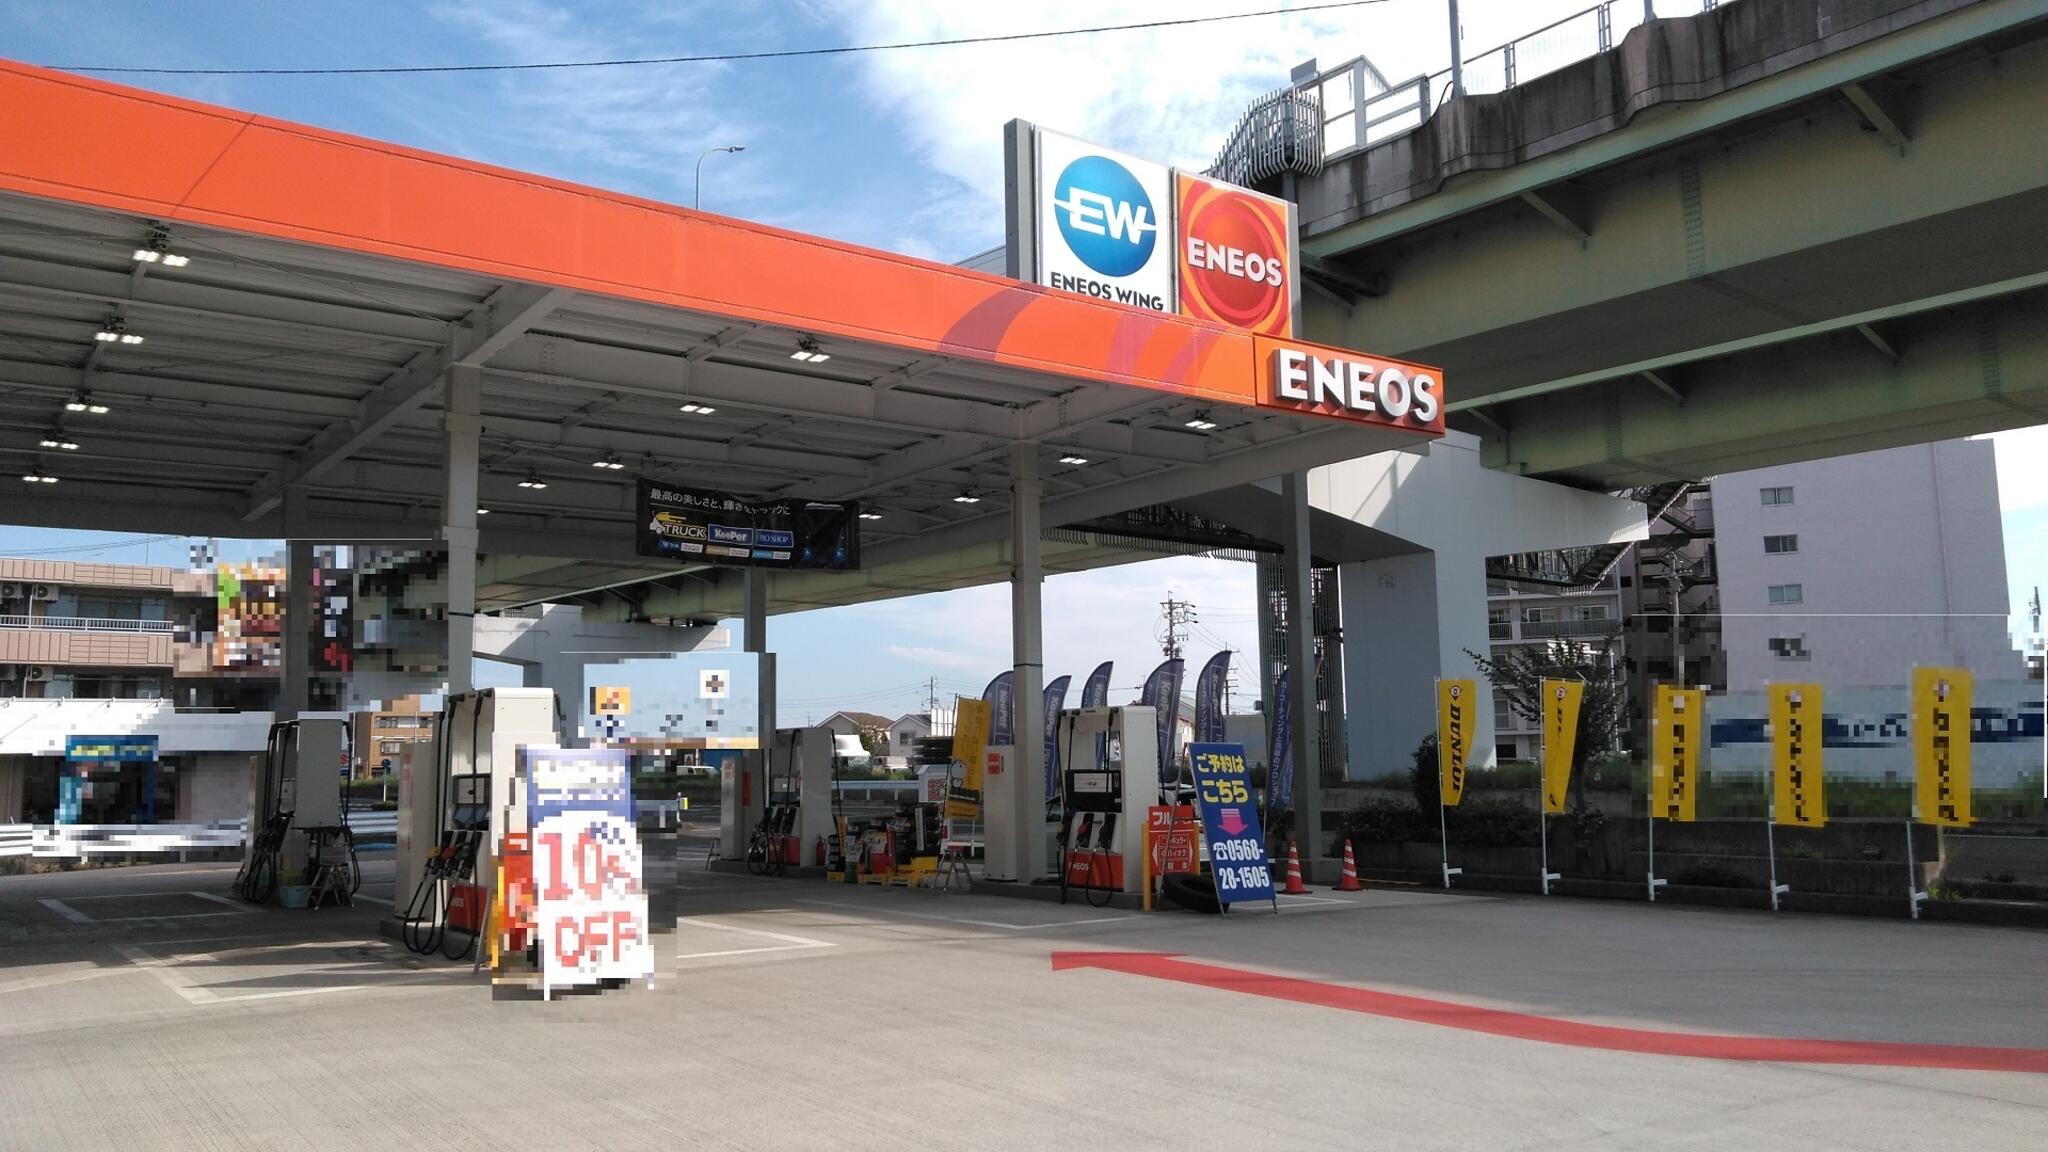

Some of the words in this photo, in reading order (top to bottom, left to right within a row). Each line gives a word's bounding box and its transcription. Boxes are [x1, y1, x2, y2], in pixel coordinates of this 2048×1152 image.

[1066, 186, 1148, 245] EW
[1187, 236, 1282, 288] ENEOS
[1050, 272, 1113, 301] ENEOS
[1115, 287, 1164, 312] WING
[1275, 348, 1439, 424] ENEOS
[665, 523, 706, 538] TRUCK
[1196, 753, 1246, 774] ご予約は
[1201, 778, 1249, 803] こちら
[1219, 865, 1270, 890] 28-1505
